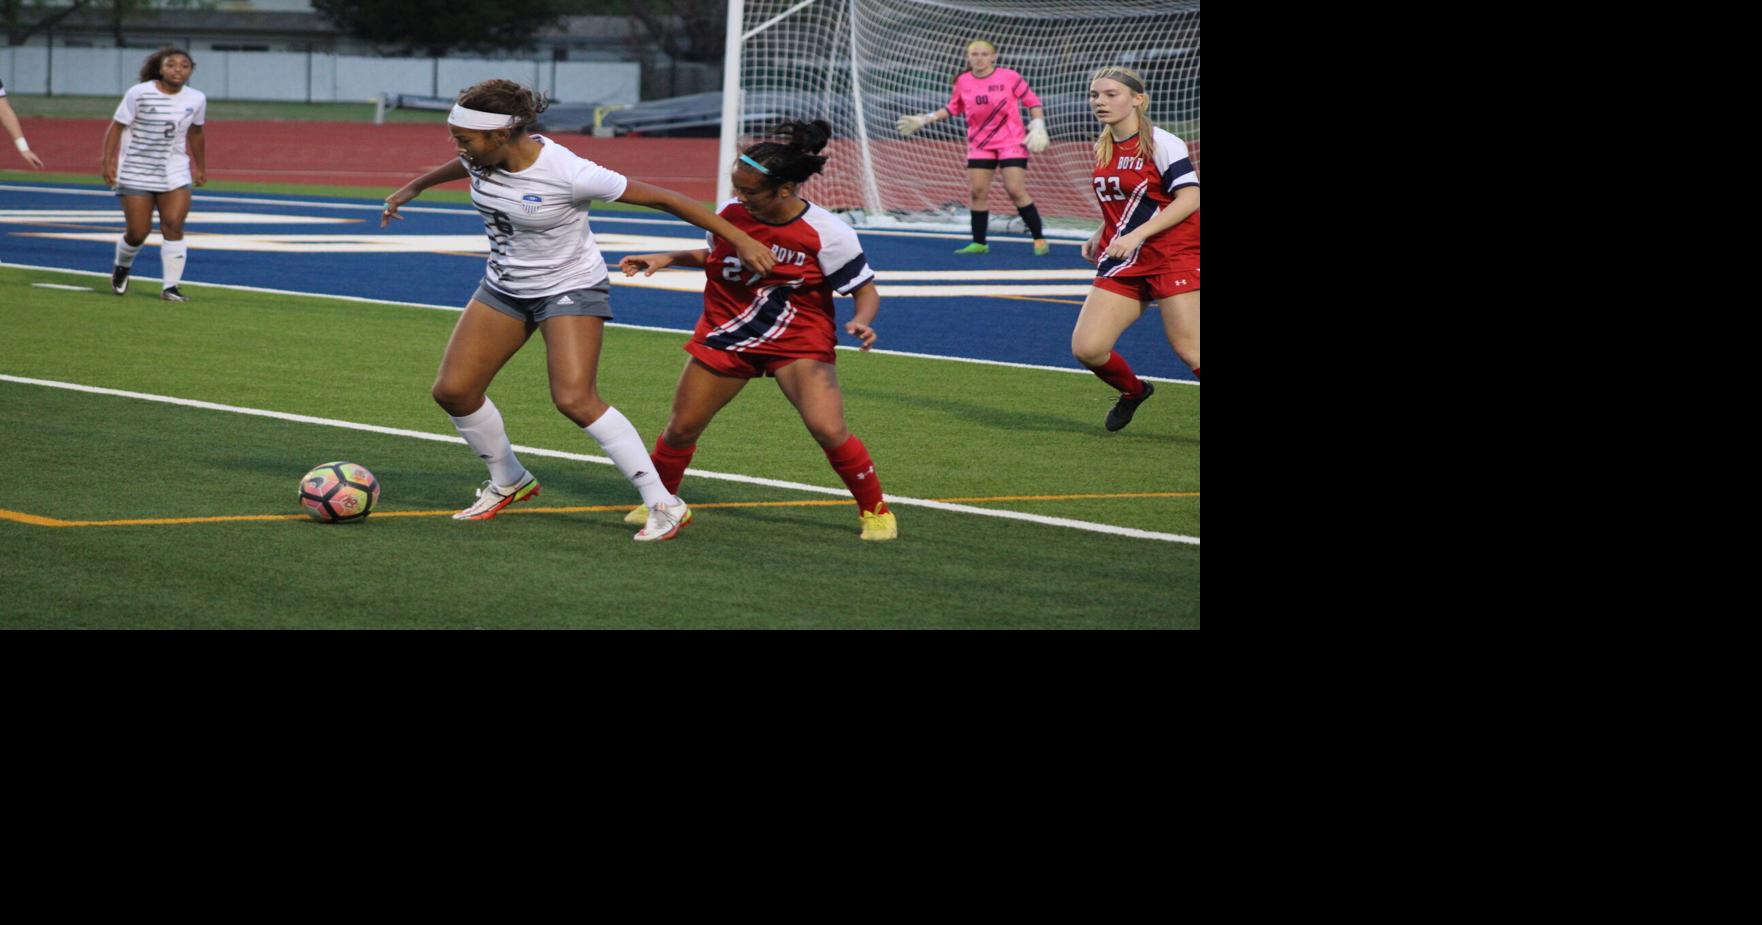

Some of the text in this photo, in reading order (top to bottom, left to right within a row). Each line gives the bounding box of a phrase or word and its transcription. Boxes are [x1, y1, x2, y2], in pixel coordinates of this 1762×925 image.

[976, 95, 988, 105] 00
[164, 121, 176, 139] 2
[1116, 156, 1144, 171] BOYD
[1094, 176, 1126, 202] 23
